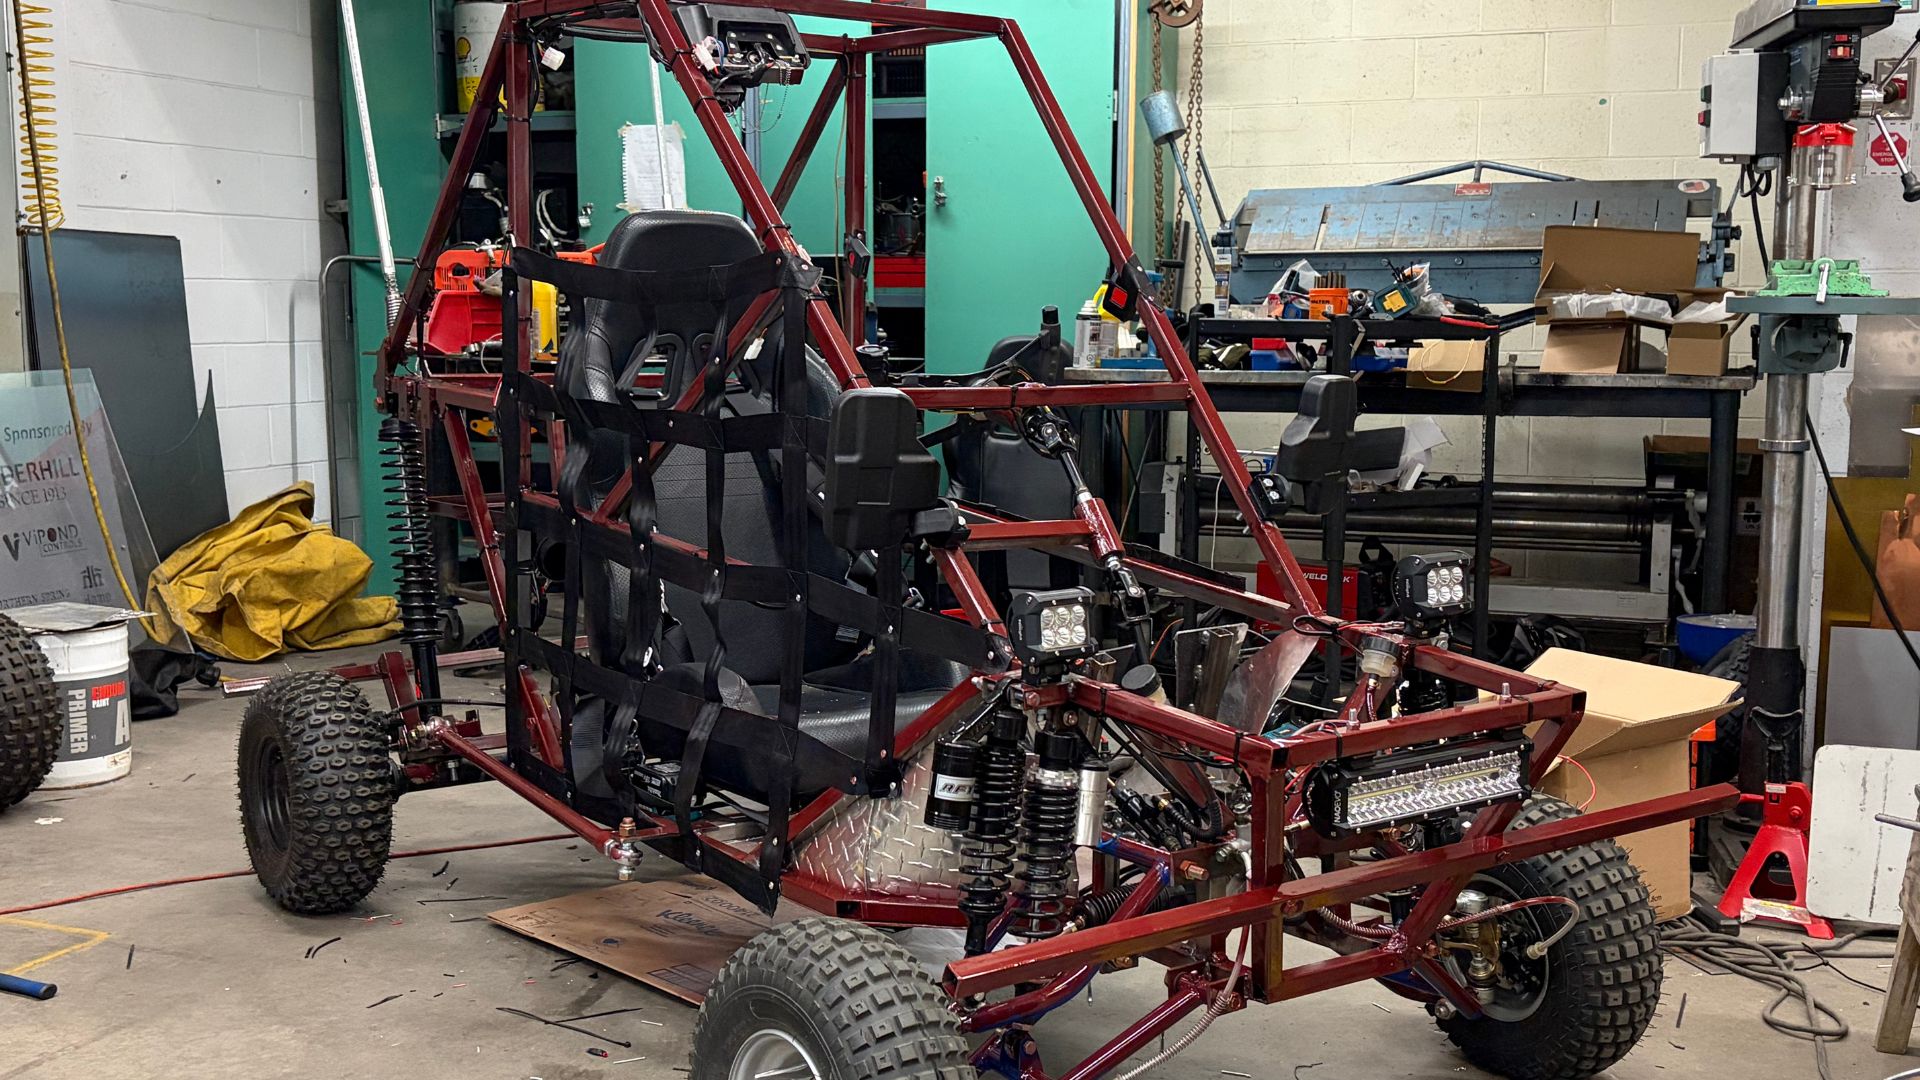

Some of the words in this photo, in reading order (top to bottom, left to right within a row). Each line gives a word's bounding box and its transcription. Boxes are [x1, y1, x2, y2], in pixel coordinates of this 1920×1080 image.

[4, 420, 71, 444] Sponsored
[42, 486, 67, 503] 1913
[1302, 572, 1351, 583] WELDK
[68, 688, 89, 754] PRIMER
